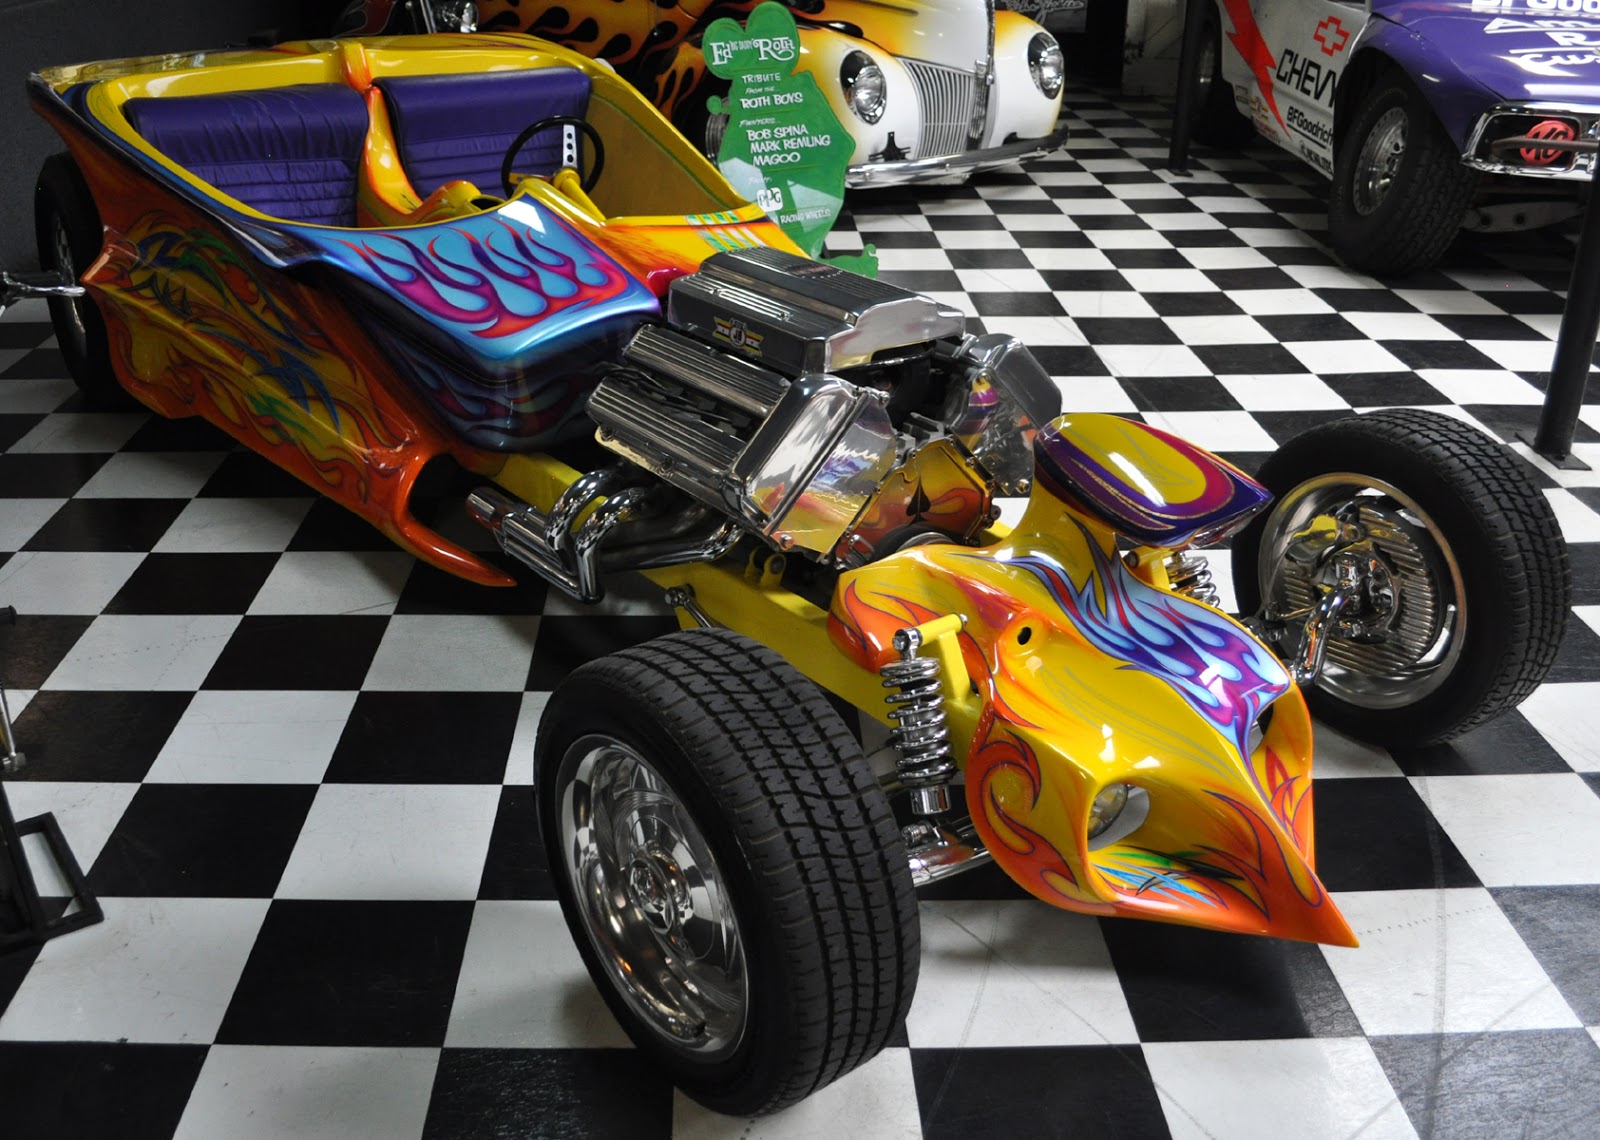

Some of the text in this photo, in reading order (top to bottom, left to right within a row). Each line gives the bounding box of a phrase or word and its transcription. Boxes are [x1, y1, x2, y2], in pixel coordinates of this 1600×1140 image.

[709, 42, 733, 65] Ed
[741, 73, 781, 84] TRIBUTE
[740, 92, 803, 109] ROTH BOYS
[746, 124, 808, 141] BOB SPINA
[1286, 105, 1333, 146] BFGoodrich
[751, 135, 831, 154] MARK REMLING
[753, 152, 801, 166] MAGOO
[759, 187, 781, 208] PPG
[780, 212, 804, 224] RACING
